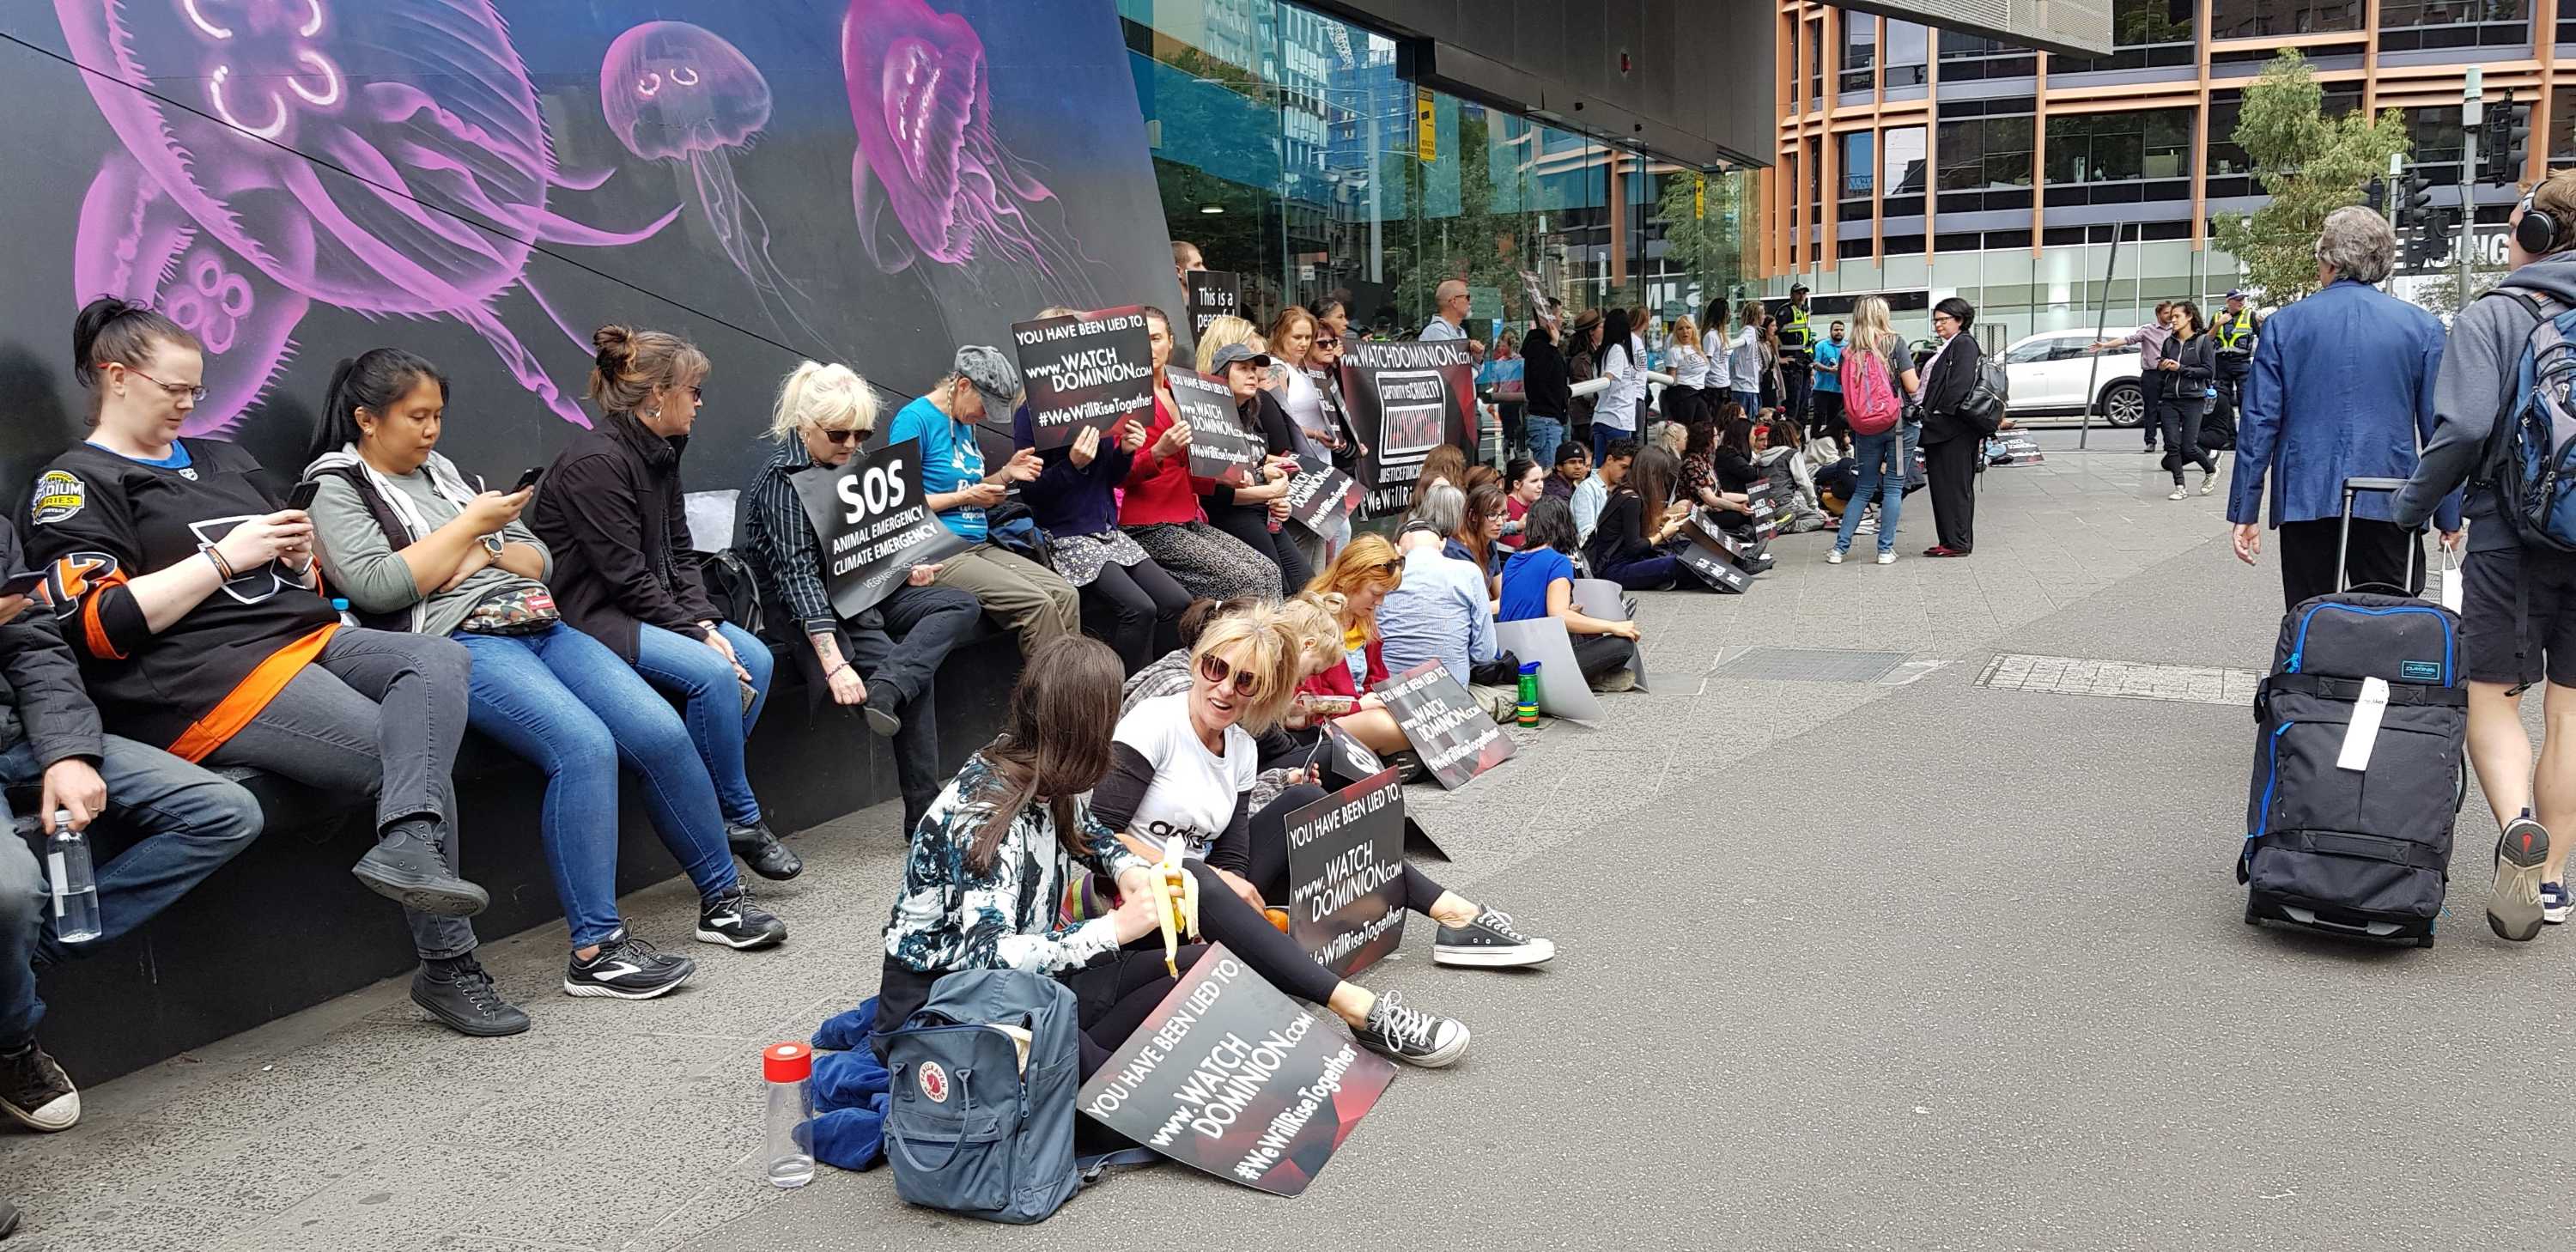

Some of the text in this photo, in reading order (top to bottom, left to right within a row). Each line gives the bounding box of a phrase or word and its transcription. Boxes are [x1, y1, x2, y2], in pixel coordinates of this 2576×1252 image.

[1198, 287, 1233, 307] This is a
[1016, 330, 1043, 345] YOU
[1046, 325, 1077, 341] HAVE
[1078, 319, 1106, 335] BEEN
[1107, 317, 1127, 332] LIED
[1038, 392, 1153, 427] #WeWillRiseTogether
[1169, 373, 1183, 386] YOU
[1182, 376, 1200, 389] HAVE
[1199, 380, 1212, 392] BEEN
[1212, 383, 1224, 395] LIED
[837, 459, 906, 524] SOS
[833, 505, 925, 555] ANIMAL EMERGENCY
[834, 522, 939, 576] CLIMATE EMERGENCY
[1378, 689, 1395, 702] YOU
[1392, 682, 1410, 698] HAVE
[1407, 676, 1425, 691] BEEN
[1423, 670, 1438, 686] LIED
[1290, 824, 1312, 850] YOU
[1315, 813, 1341, 838] HAVE
[1341, 799, 1366, 825] BEEN
[1367, 787, 1385, 812] LIED
[1309, 904, 1405, 967] eWillRiseTogether
[1086, 1078, 1129, 1119] YOU
[1121, 1049, 1165, 1091] HAVE
[1152, 1012, 1197, 1053] BEEN
[1187, 982, 1223, 1018] LIED
[1150, 1031, 1252, 1147] www.WATCH
[1233, 1042, 1359, 1181] #WeWillRiseTogether
